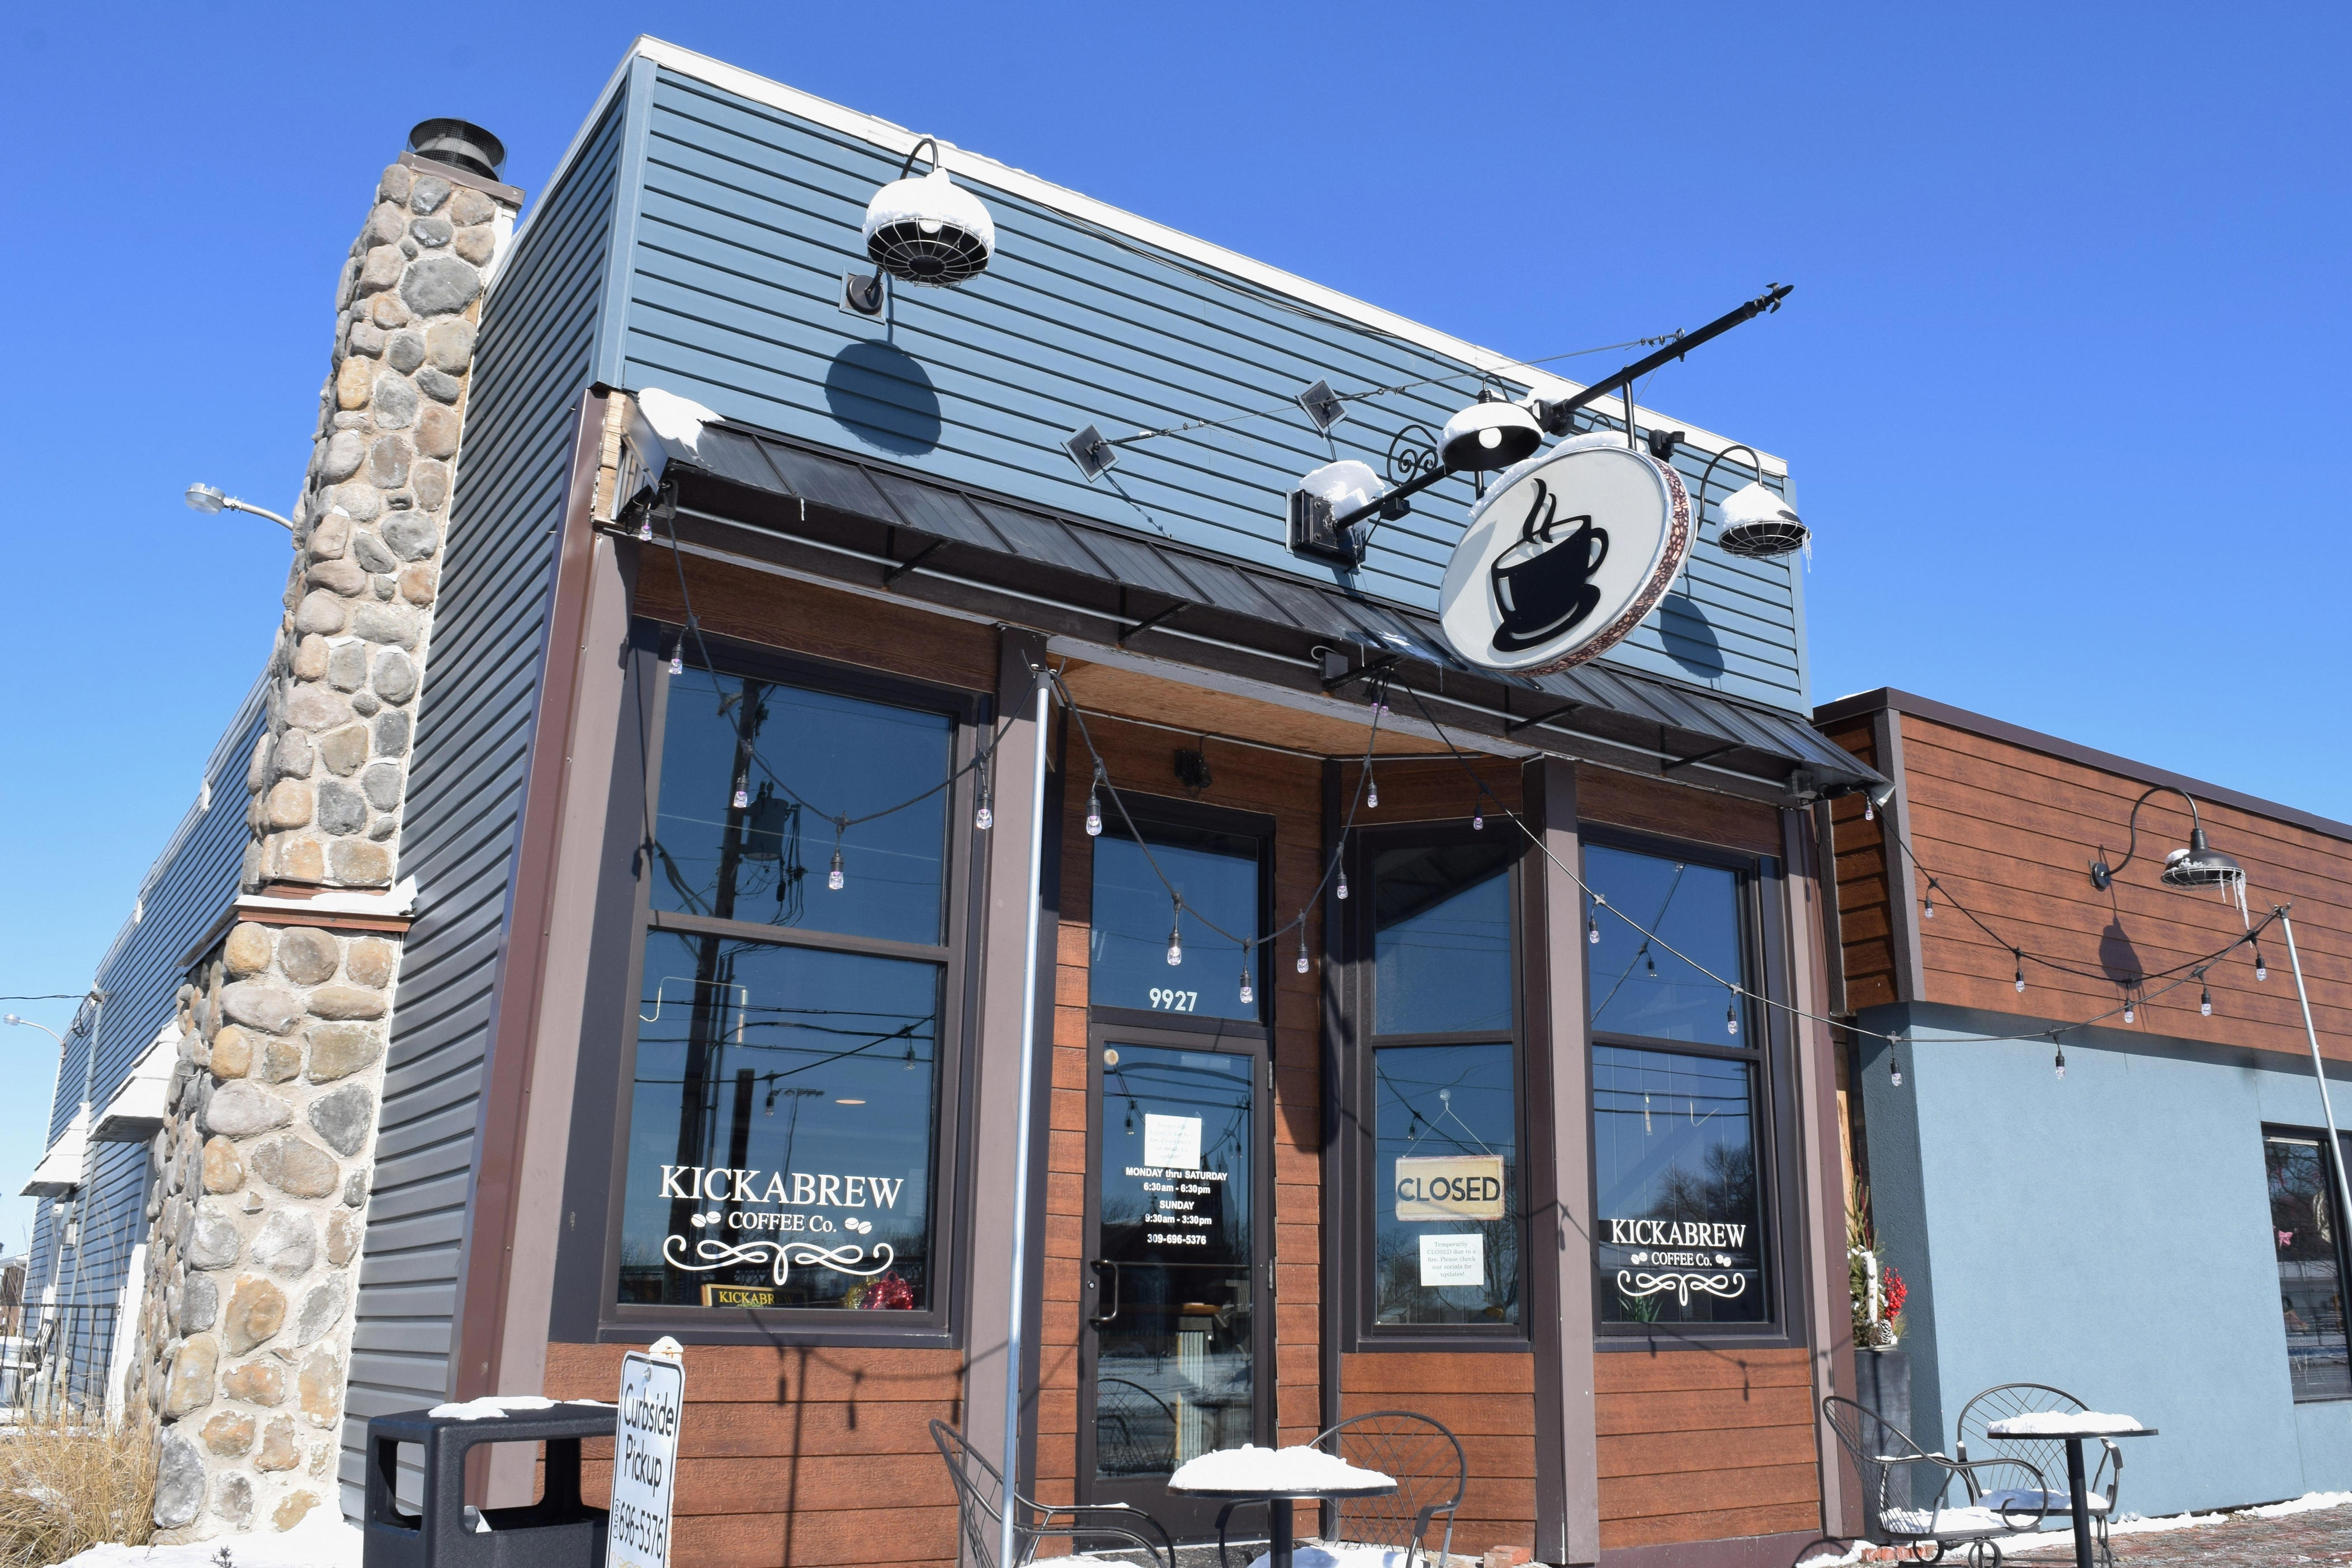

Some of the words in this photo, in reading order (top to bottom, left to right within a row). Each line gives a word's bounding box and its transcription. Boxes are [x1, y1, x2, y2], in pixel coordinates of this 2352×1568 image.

[1149, 988, 1198, 1012] 9927
[1126, 1167, 1163, 1177] MONDAY
[1165, 1170, 1182, 1178] thru
[1184, 1170, 1227, 1180] SATURDAY
[658, 1165, 904, 1209] KICKABREW
[1143, 1182, 1174, 1192] 6:30am
[1180, 1184, 1211, 1195] 6:30pm
[1397, 1177, 1500, 1201] CLOSED
[1159, 1200, 1194, 1210] SUNDAY
[728, 1211, 805, 1231] COFFEE
[809, 1215, 837, 1232] Co.
[1145, 1213, 1175, 1224] 9:30am
[1182, 1215, 1212, 1226] 3:30pm
[1147, 1234, 1206, 1245] 309-696-5376
[1610, 1218, 1746, 1248] KICKABREW
[1651, 1251, 1694, 1266] COFFEE
[1695, 1253, 1712, 1267] Co.
[624, 1383, 674, 1437] Curbside
[625, 1434, 662, 1497] Pickup
[619, 1501, 663, 1559] 696-5376
